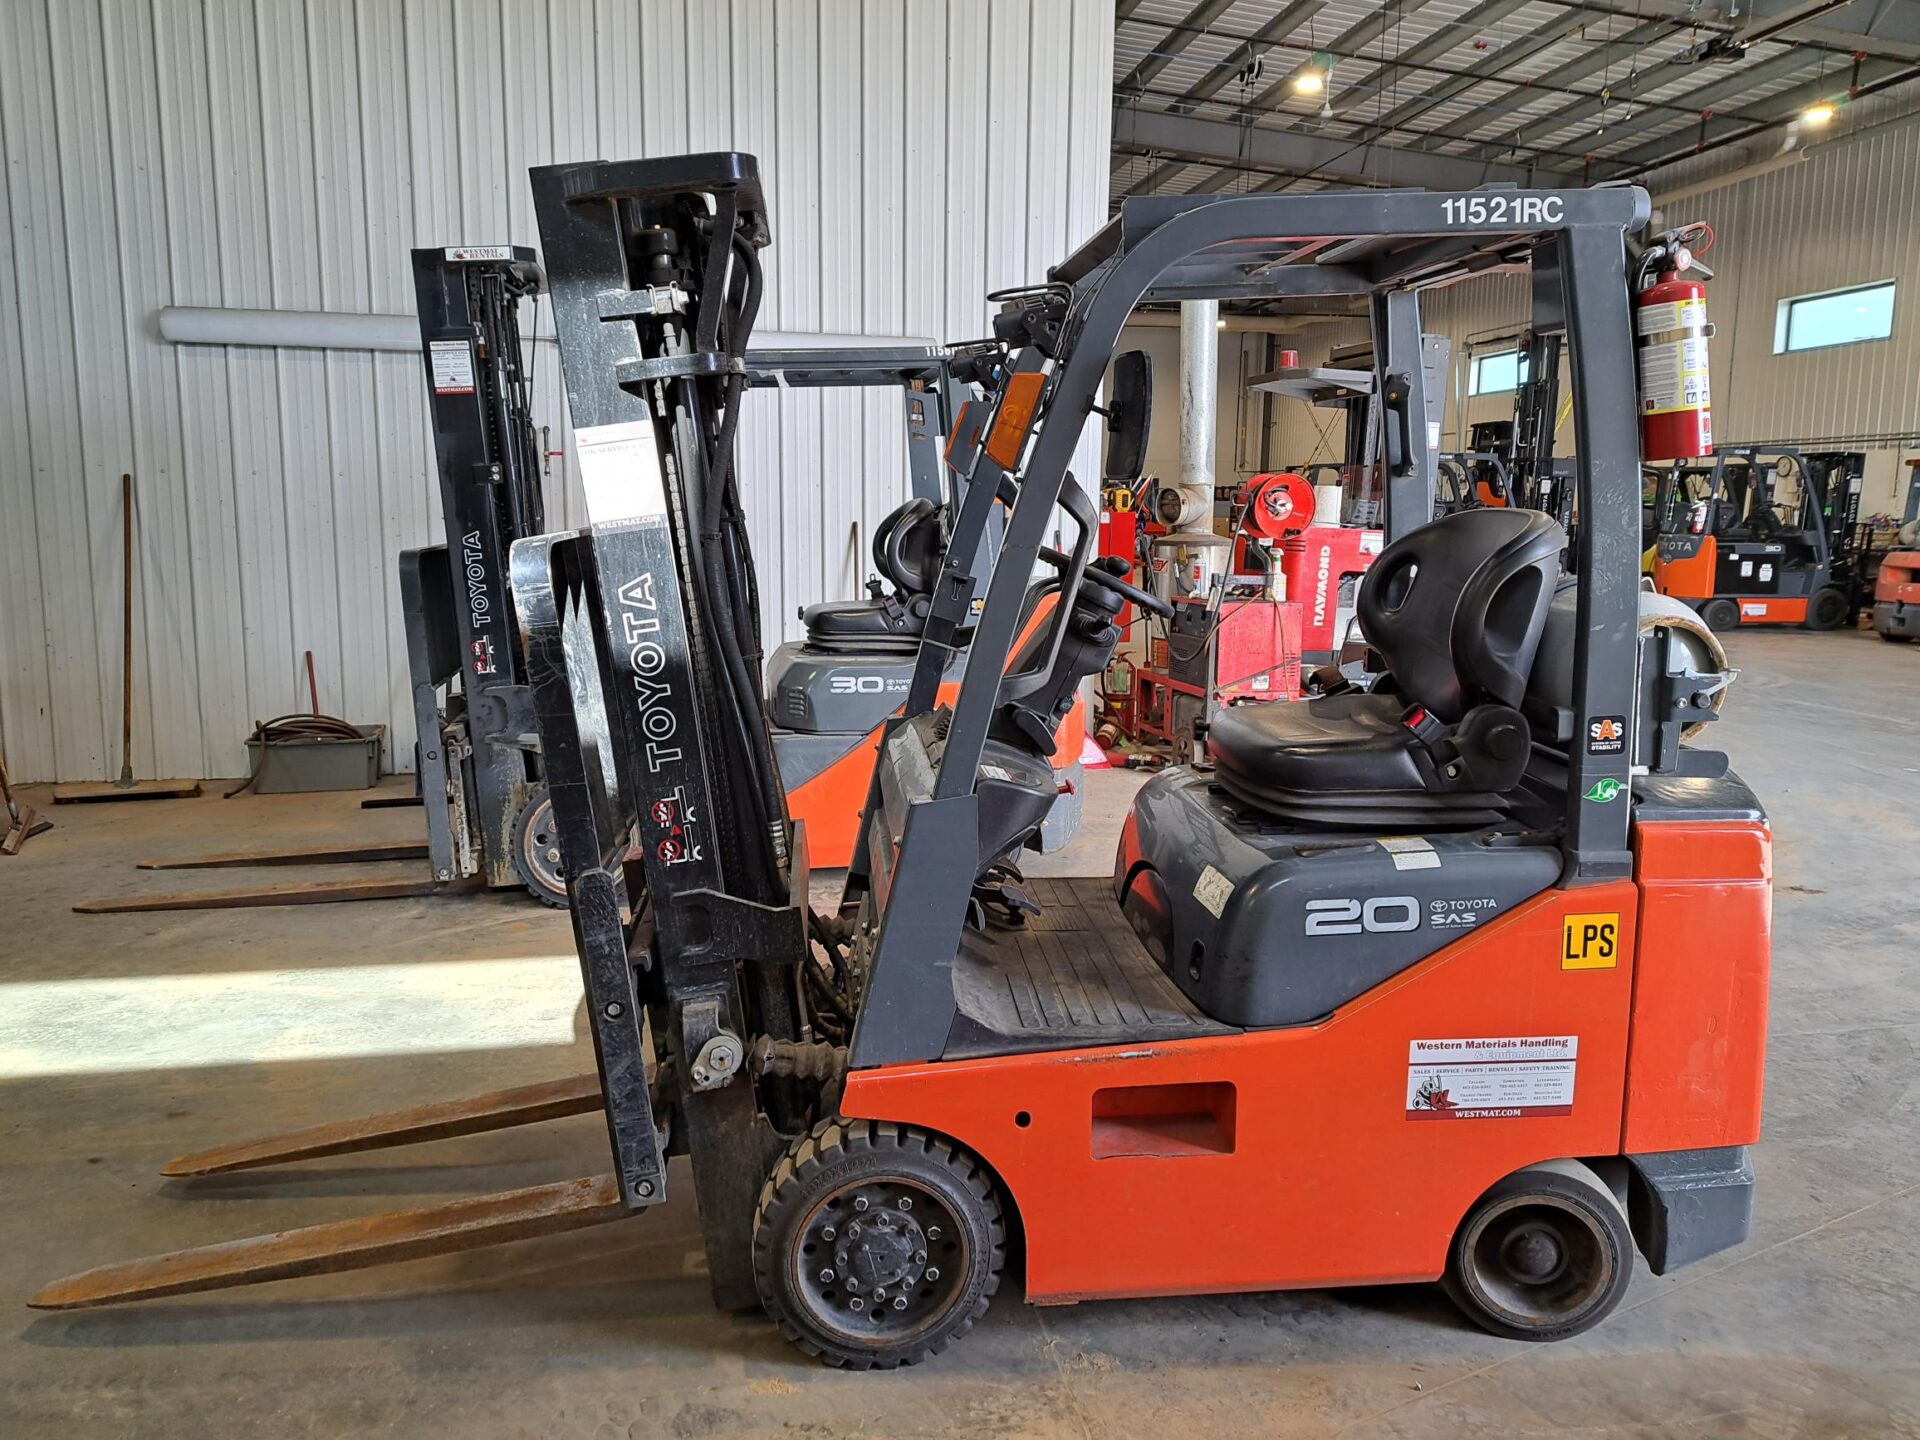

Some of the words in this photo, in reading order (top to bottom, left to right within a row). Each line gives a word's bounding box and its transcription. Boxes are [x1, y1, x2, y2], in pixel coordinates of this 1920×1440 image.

[1440, 196, 1564, 224] 11521RC
[597, 515, 660, 530] WESTMAT.COM
[462, 530, 491, 628] TOYOTA
[1313, 545, 1331, 626] RAYMOND
[618, 572, 682, 773] TOYOTA
[830, 676, 884, 694] 30
[1590, 719, 1623, 740] SAS
[1449, 898, 1497, 910] TOYOTA
[1305, 896, 1420, 936] 20
[1430, 912, 1477, 924] SAS
[1565, 924, 1615, 960] LPS
[1416, 1041, 1462, 1051] Western
[1465, 1039, 1517, 1049] Materials
[1520, 1038, 1569, 1048] Handling
[1485, 1049, 1545, 1061] Equipment
[1455, 1108, 1521, 1118] WESTMAT.COM
